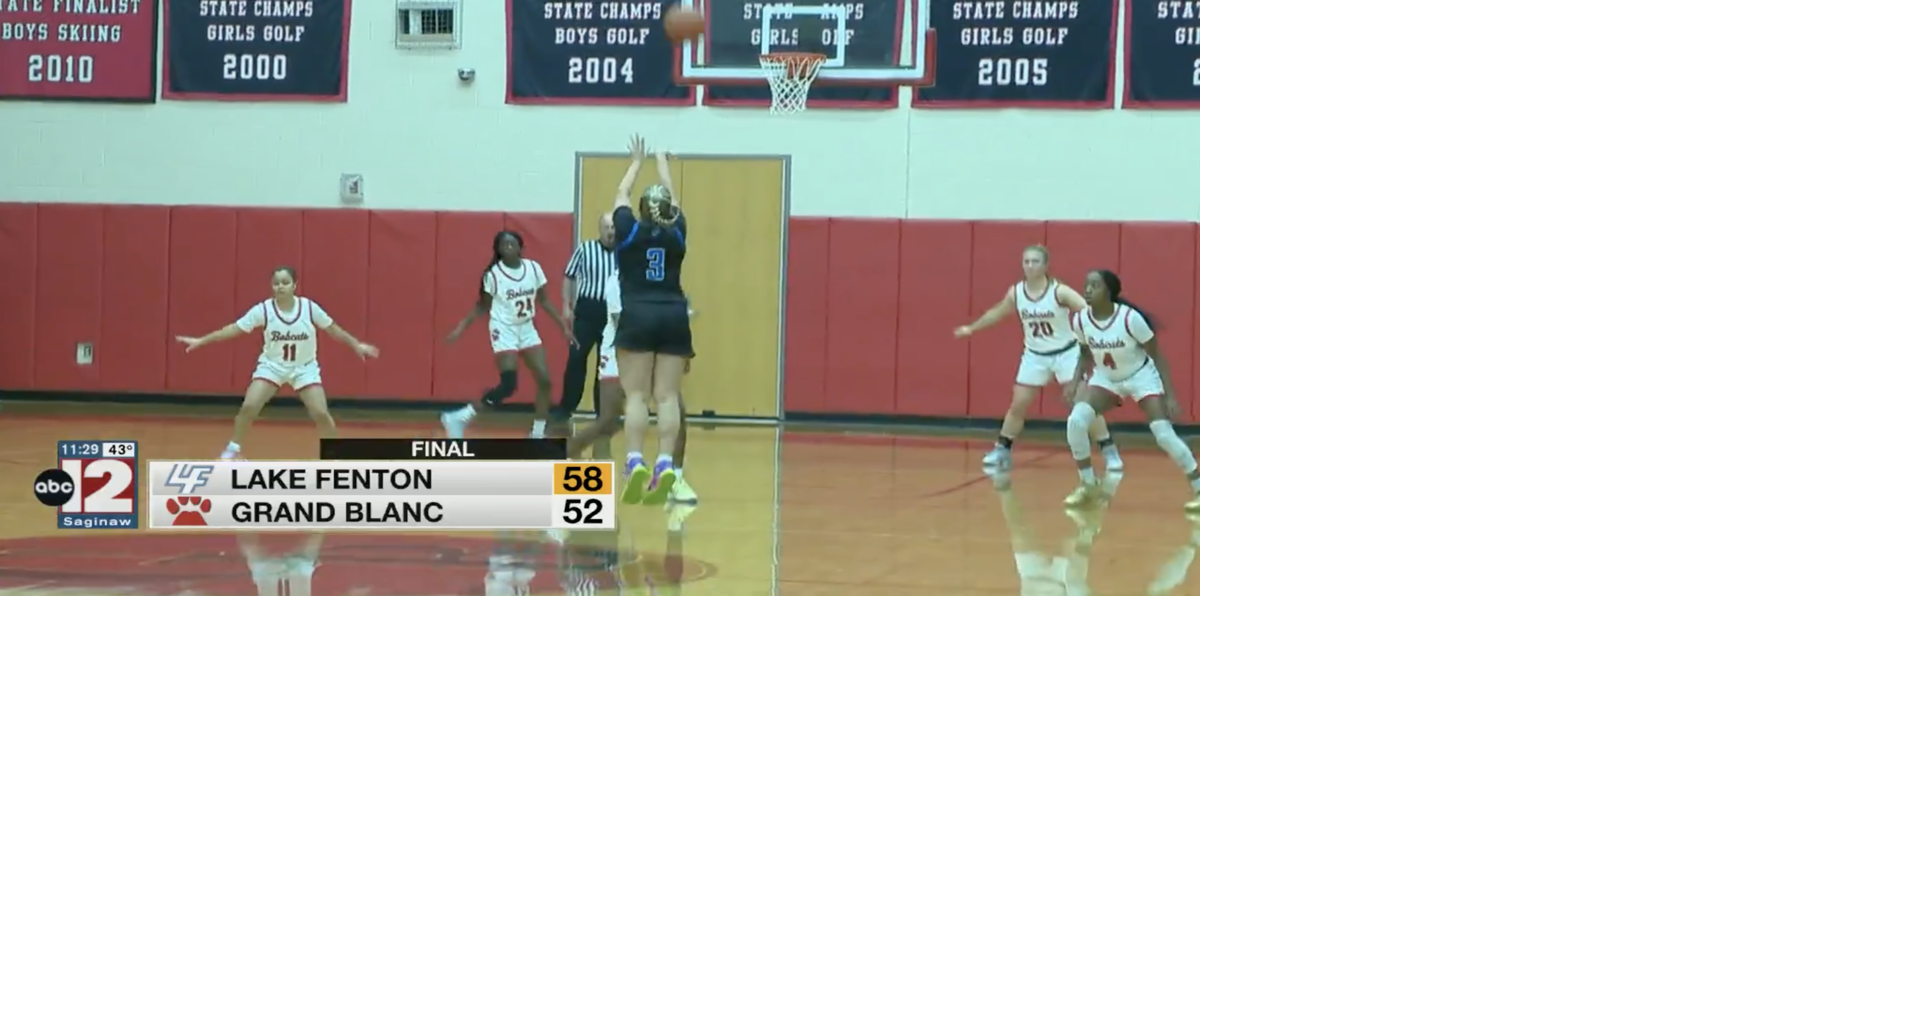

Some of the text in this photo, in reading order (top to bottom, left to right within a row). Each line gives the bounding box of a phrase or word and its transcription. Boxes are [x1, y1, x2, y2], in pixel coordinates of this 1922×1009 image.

[53, 0, 140, 14] FINALIST
[200, 1, 313, 17] STATE CHAMPS
[544, 2, 662, 20] STATE CHAMPS
[953, 2, 1079, 19] STATE CHAMPS
[2, 22, 121, 42] BOYS SKIING
[207, 25, 305, 42] GIRLS GOLF
[555, 27, 650, 45] BOYS GOLF
[751, 28, 799, 45] GRLS
[961, 28, 1068, 45] GIRLS GOLF
[28, 54, 94, 83] 2010
[223, 54, 287, 79] 2000
[568, 57, 634, 84] 2004
[978, 58, 1048, 86] 2005
[646, 247, 666, 281] 3
[271, 330, 309, 342] Bobcats
[1029, 320, 1054, 338] 20
[282, 343, 297, 362] 11
[1103, 352, 1117, 370] 4
